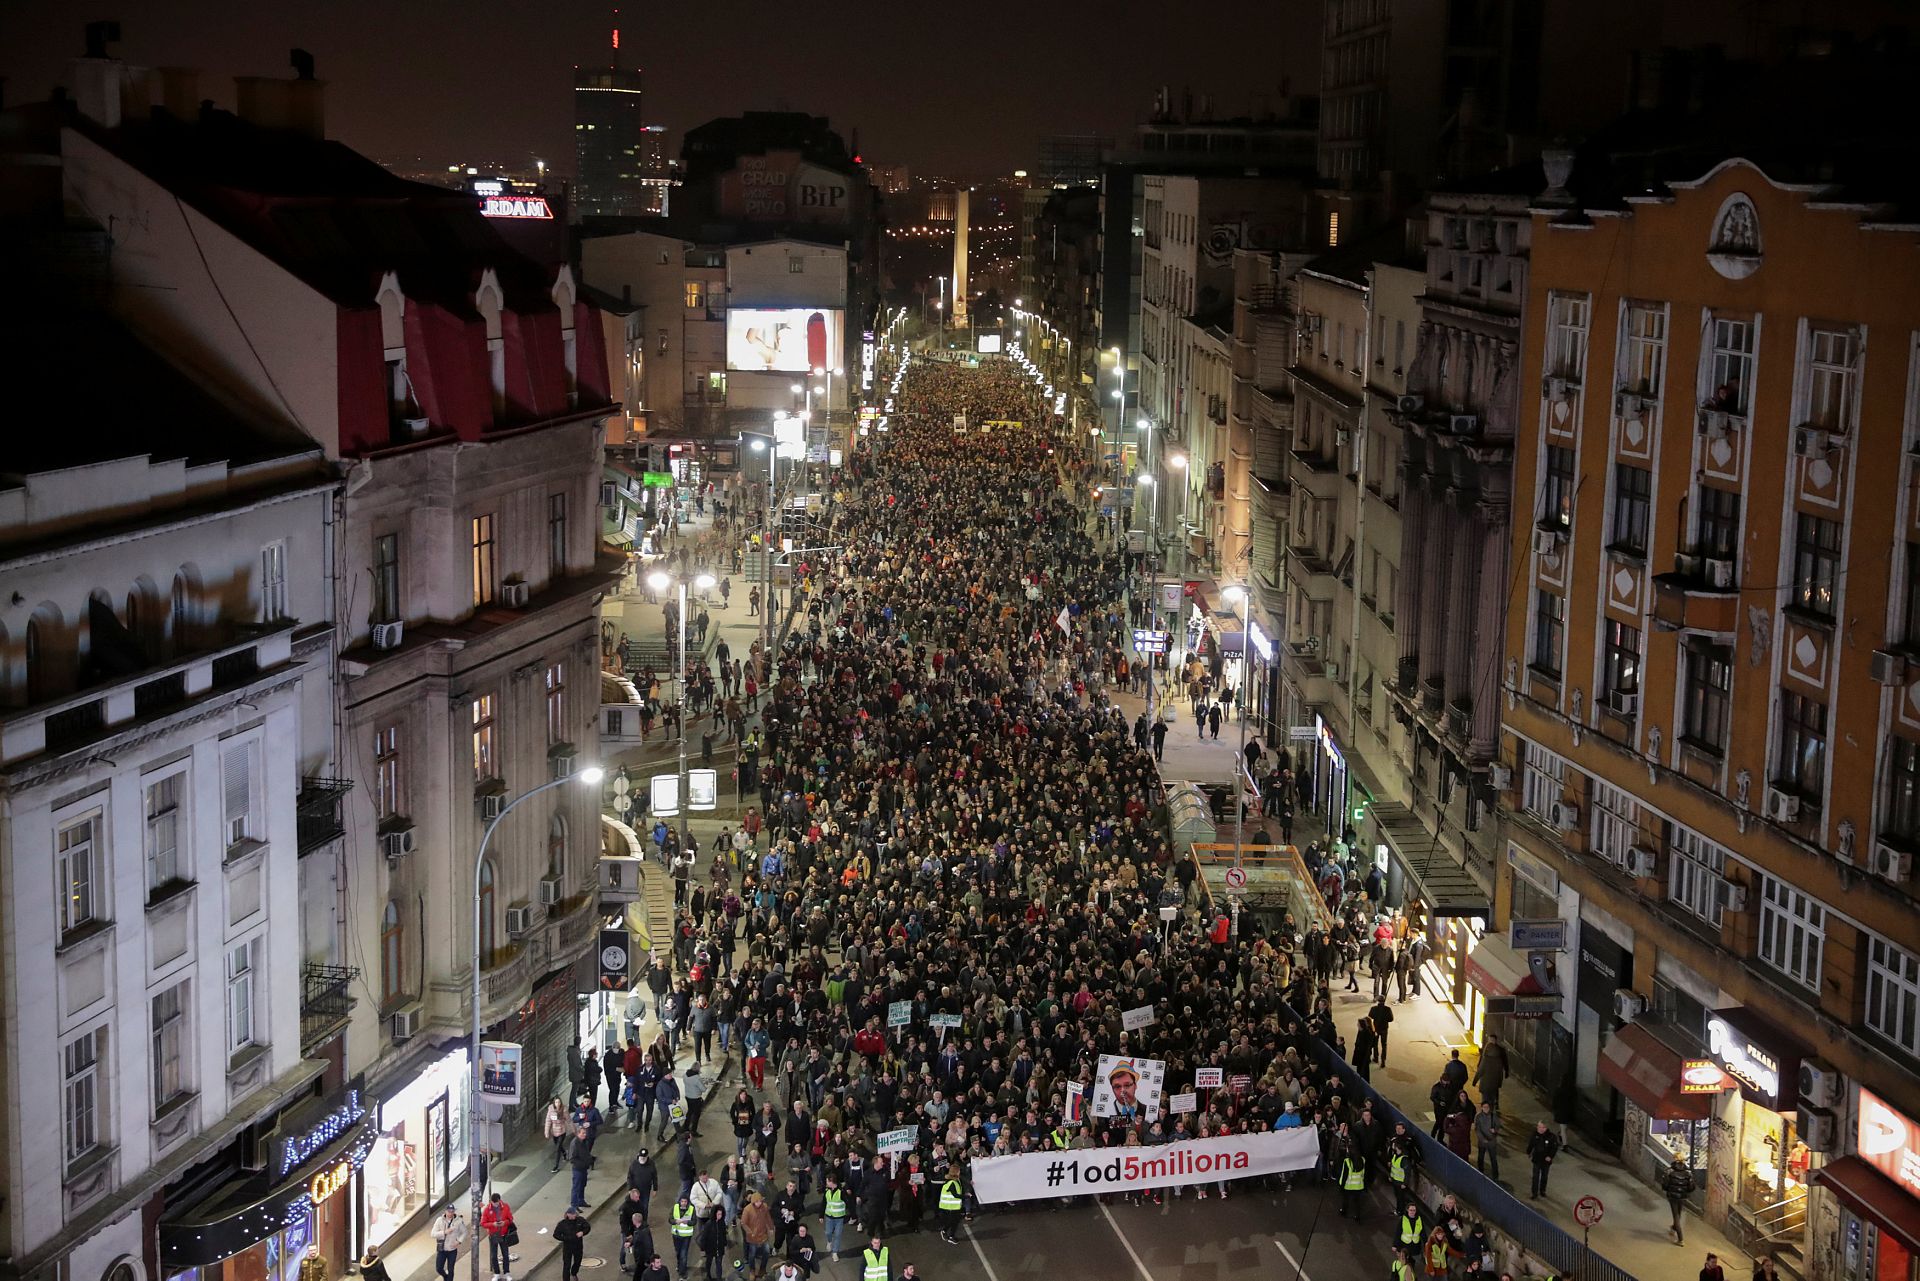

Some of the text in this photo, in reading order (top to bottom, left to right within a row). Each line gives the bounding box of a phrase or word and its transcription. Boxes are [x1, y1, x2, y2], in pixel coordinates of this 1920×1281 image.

[481, 200, 545, 216] RDAM
[862, 343, 874, 390] HOTEL
[1530, 931, 1560, 939] PANTER
[1747, 1044, 1777, 1073] PEKARA
[1046, 1148, 1250, 1187] #1od5miliona
